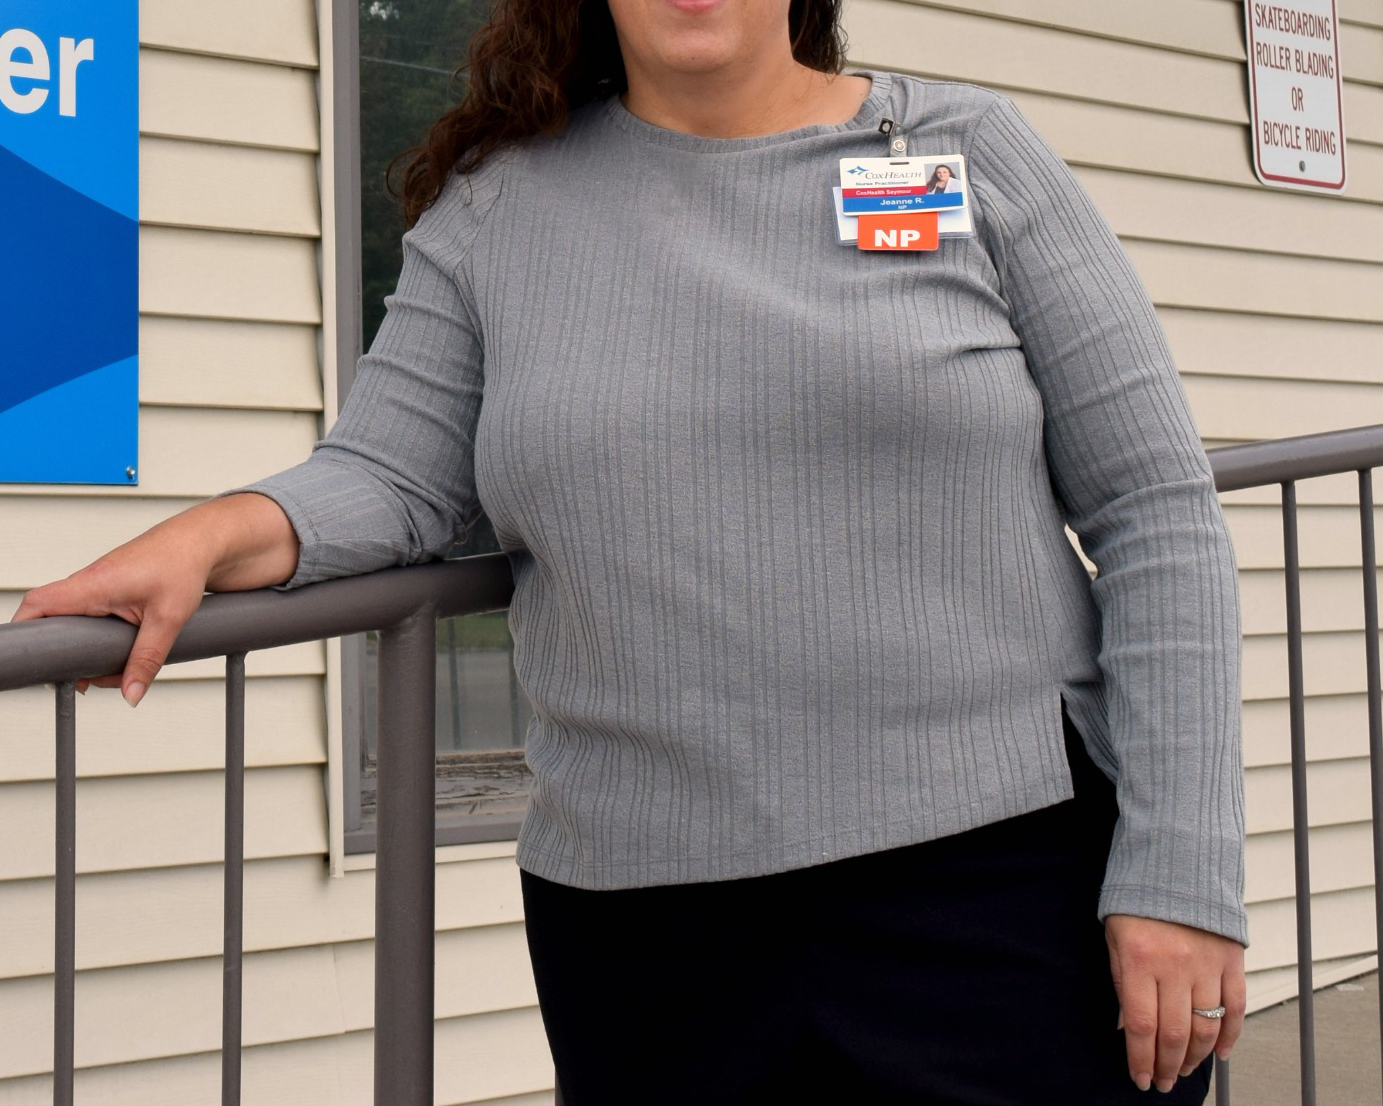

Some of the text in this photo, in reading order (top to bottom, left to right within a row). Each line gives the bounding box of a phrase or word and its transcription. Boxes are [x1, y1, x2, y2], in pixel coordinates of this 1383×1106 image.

[1254, 2, 1331, 42] SKATEBOARDING
[1255, 41, 1334, 80] ROLLER BLADING
[1291, 86, 1305, 113] OR
[1263, 120, 1337, 156] BICYCLE RIDING
[874, 229, 921, 248] NP
